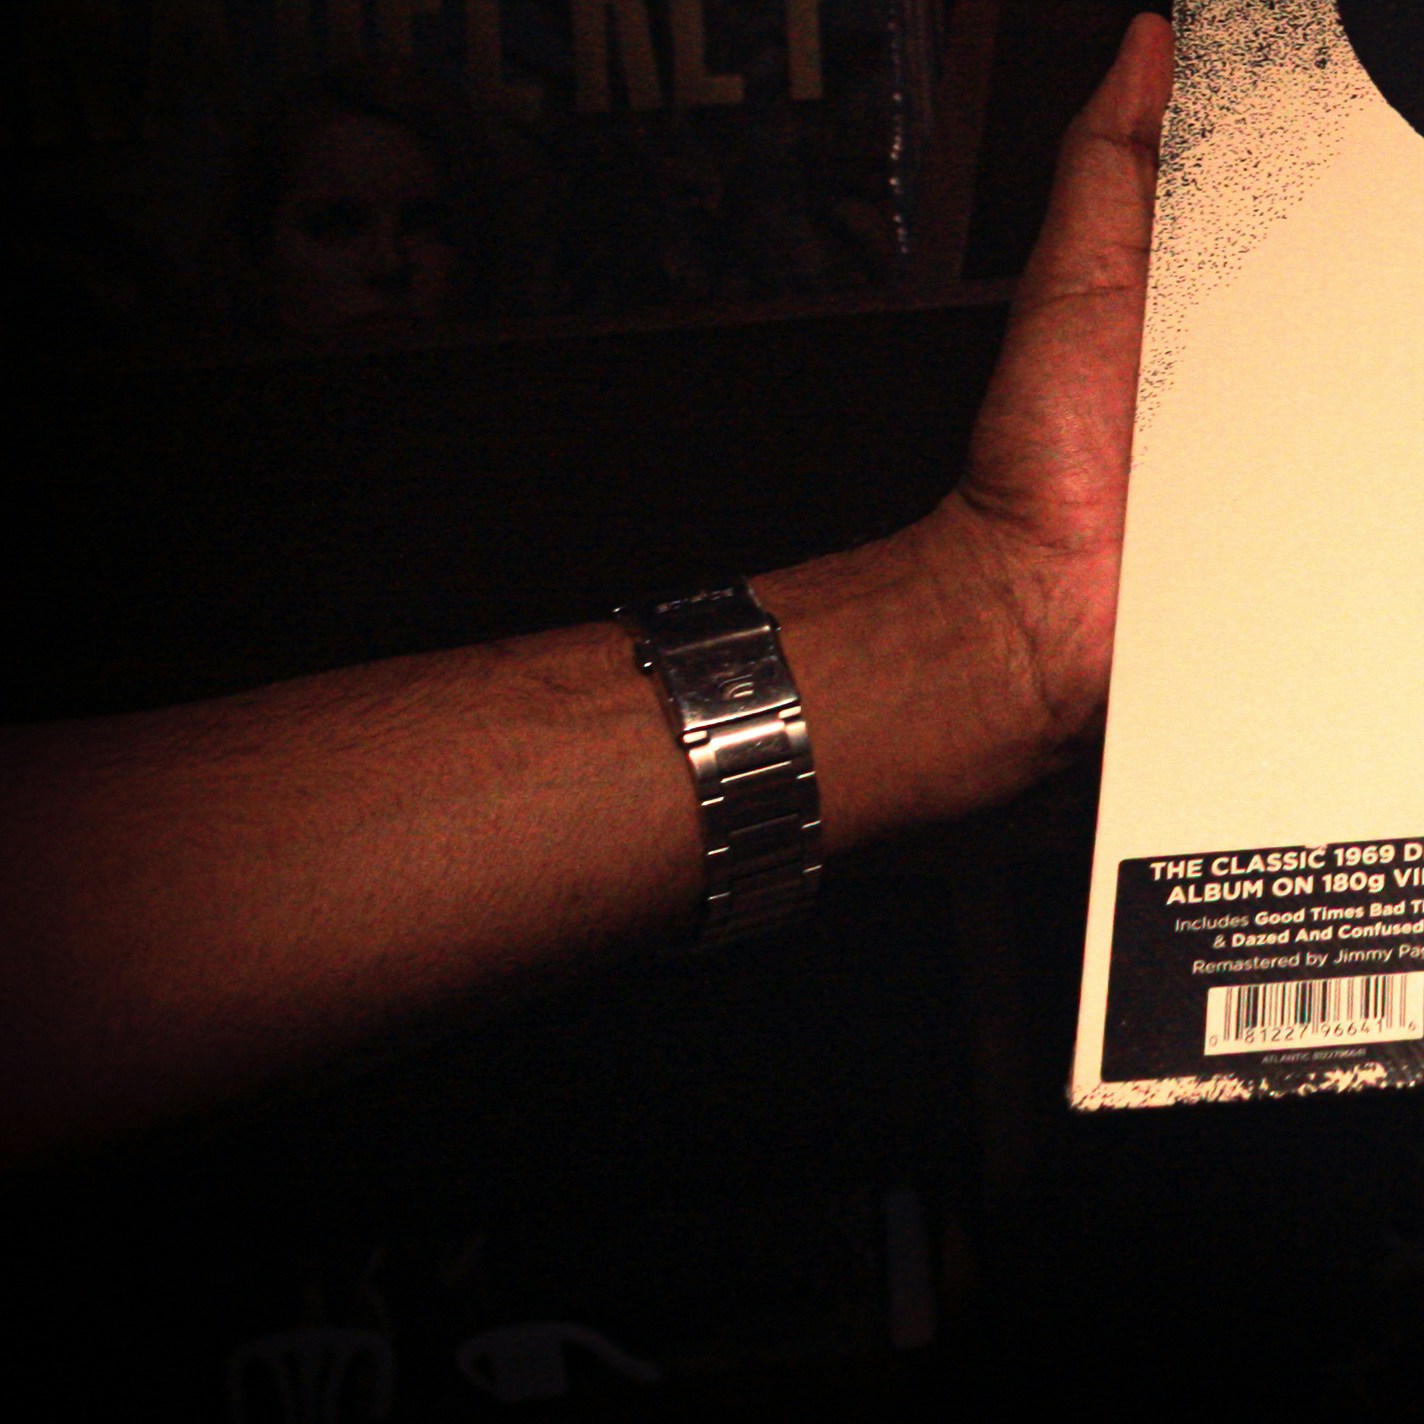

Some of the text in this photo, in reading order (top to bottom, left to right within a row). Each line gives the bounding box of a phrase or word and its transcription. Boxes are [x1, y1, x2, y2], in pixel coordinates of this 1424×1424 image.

[1150, 859, 1204, 881] THE
[1211, 849, 1326, 876] CLASSIC
[1334, 844, 1395, 867] 1969
[1165, 879, 1264, 906] ALBUM
[1272, 875, 1314, 897] ON
[1322, 871, 1385, 893] 180g
[1175, 913, 1249, 932] Includes
[1255, 908, 1305, 926] Good
[1310, 905, 1364, 921] Times
[1370, 900, 1405, 917] Bad
[1212, 919, 1424, 949] & Dazed And Confused
[1192, 951, 1300, 974] Remastered
[1305, 951, 1328, 968] by
[1333, 947, 1393, 964] Jimmy
